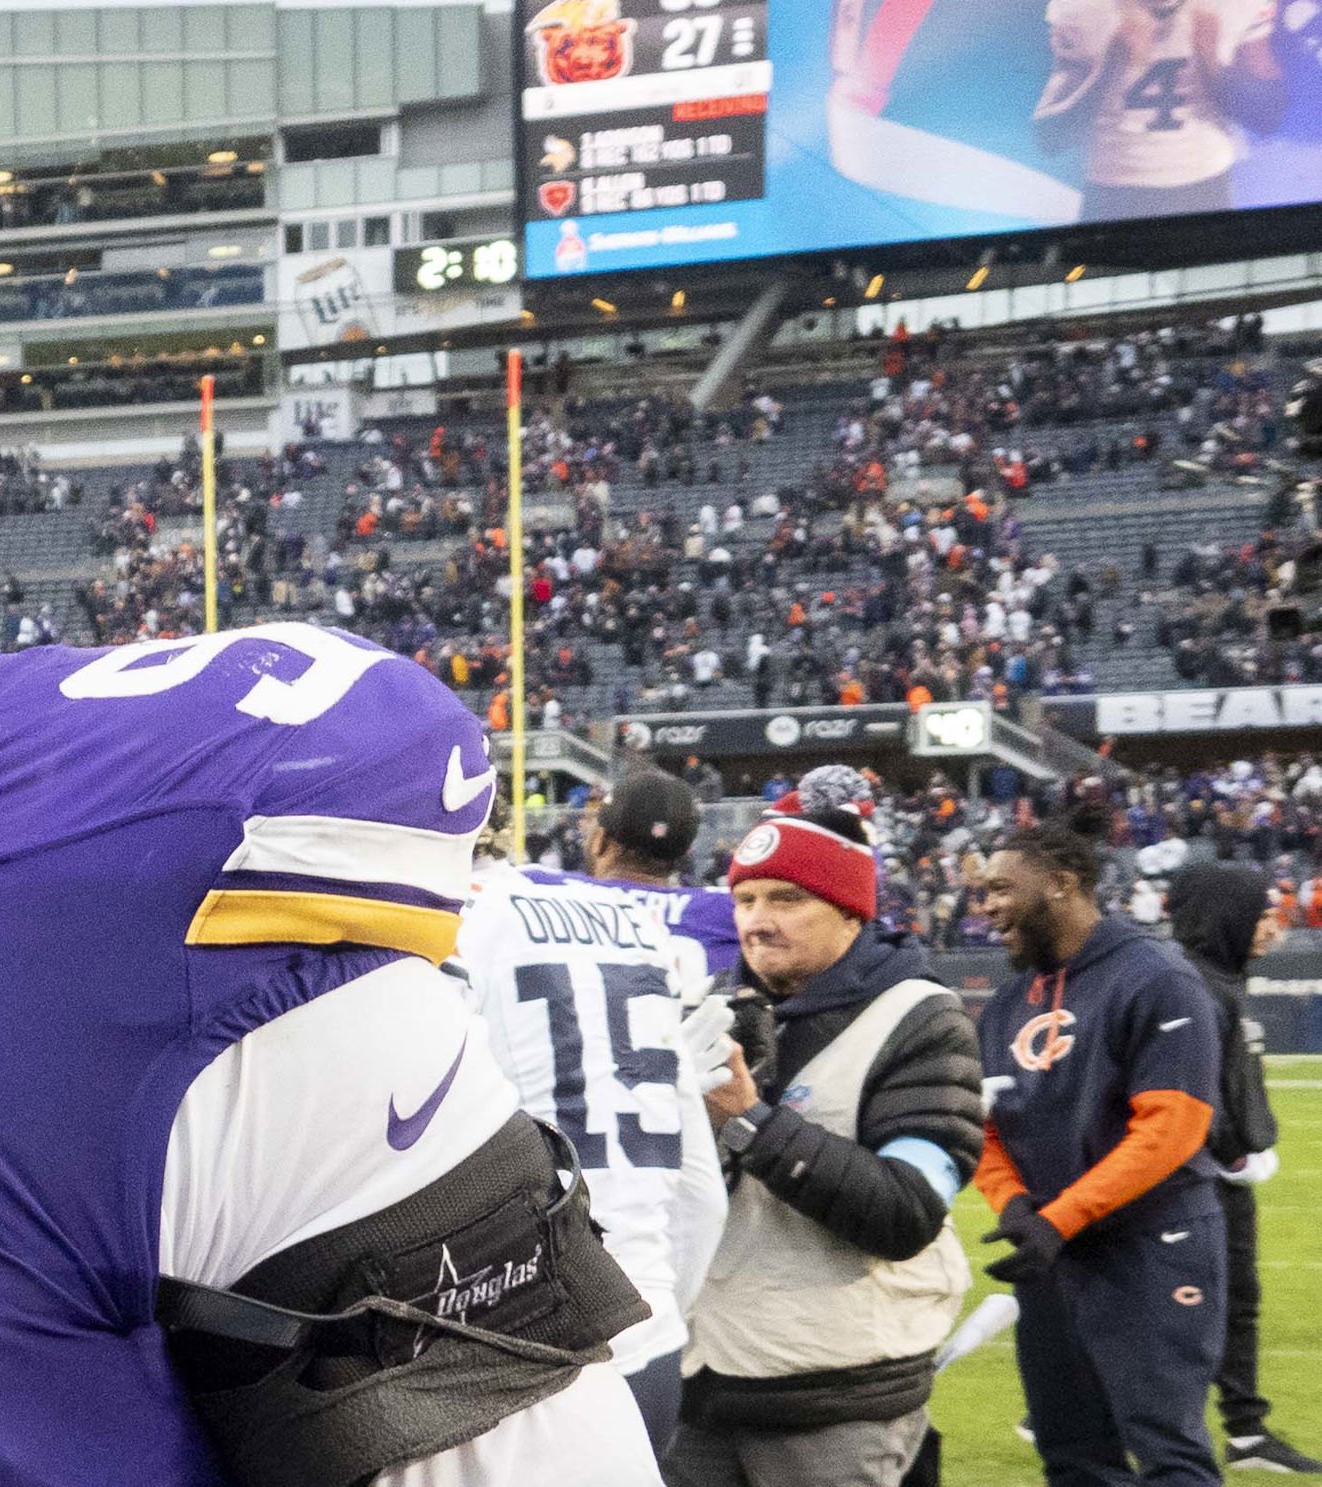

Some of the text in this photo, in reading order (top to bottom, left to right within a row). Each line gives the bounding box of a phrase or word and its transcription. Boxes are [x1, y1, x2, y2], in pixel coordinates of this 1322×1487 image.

[660, 15, 723, 69] 27
[1123, 57, 1189, 132] 4
[1096, 684, 1322, 733] BEAR
[509, 894, 657, 951] ODUNZE
[514, 962, 683, 1170] 15
